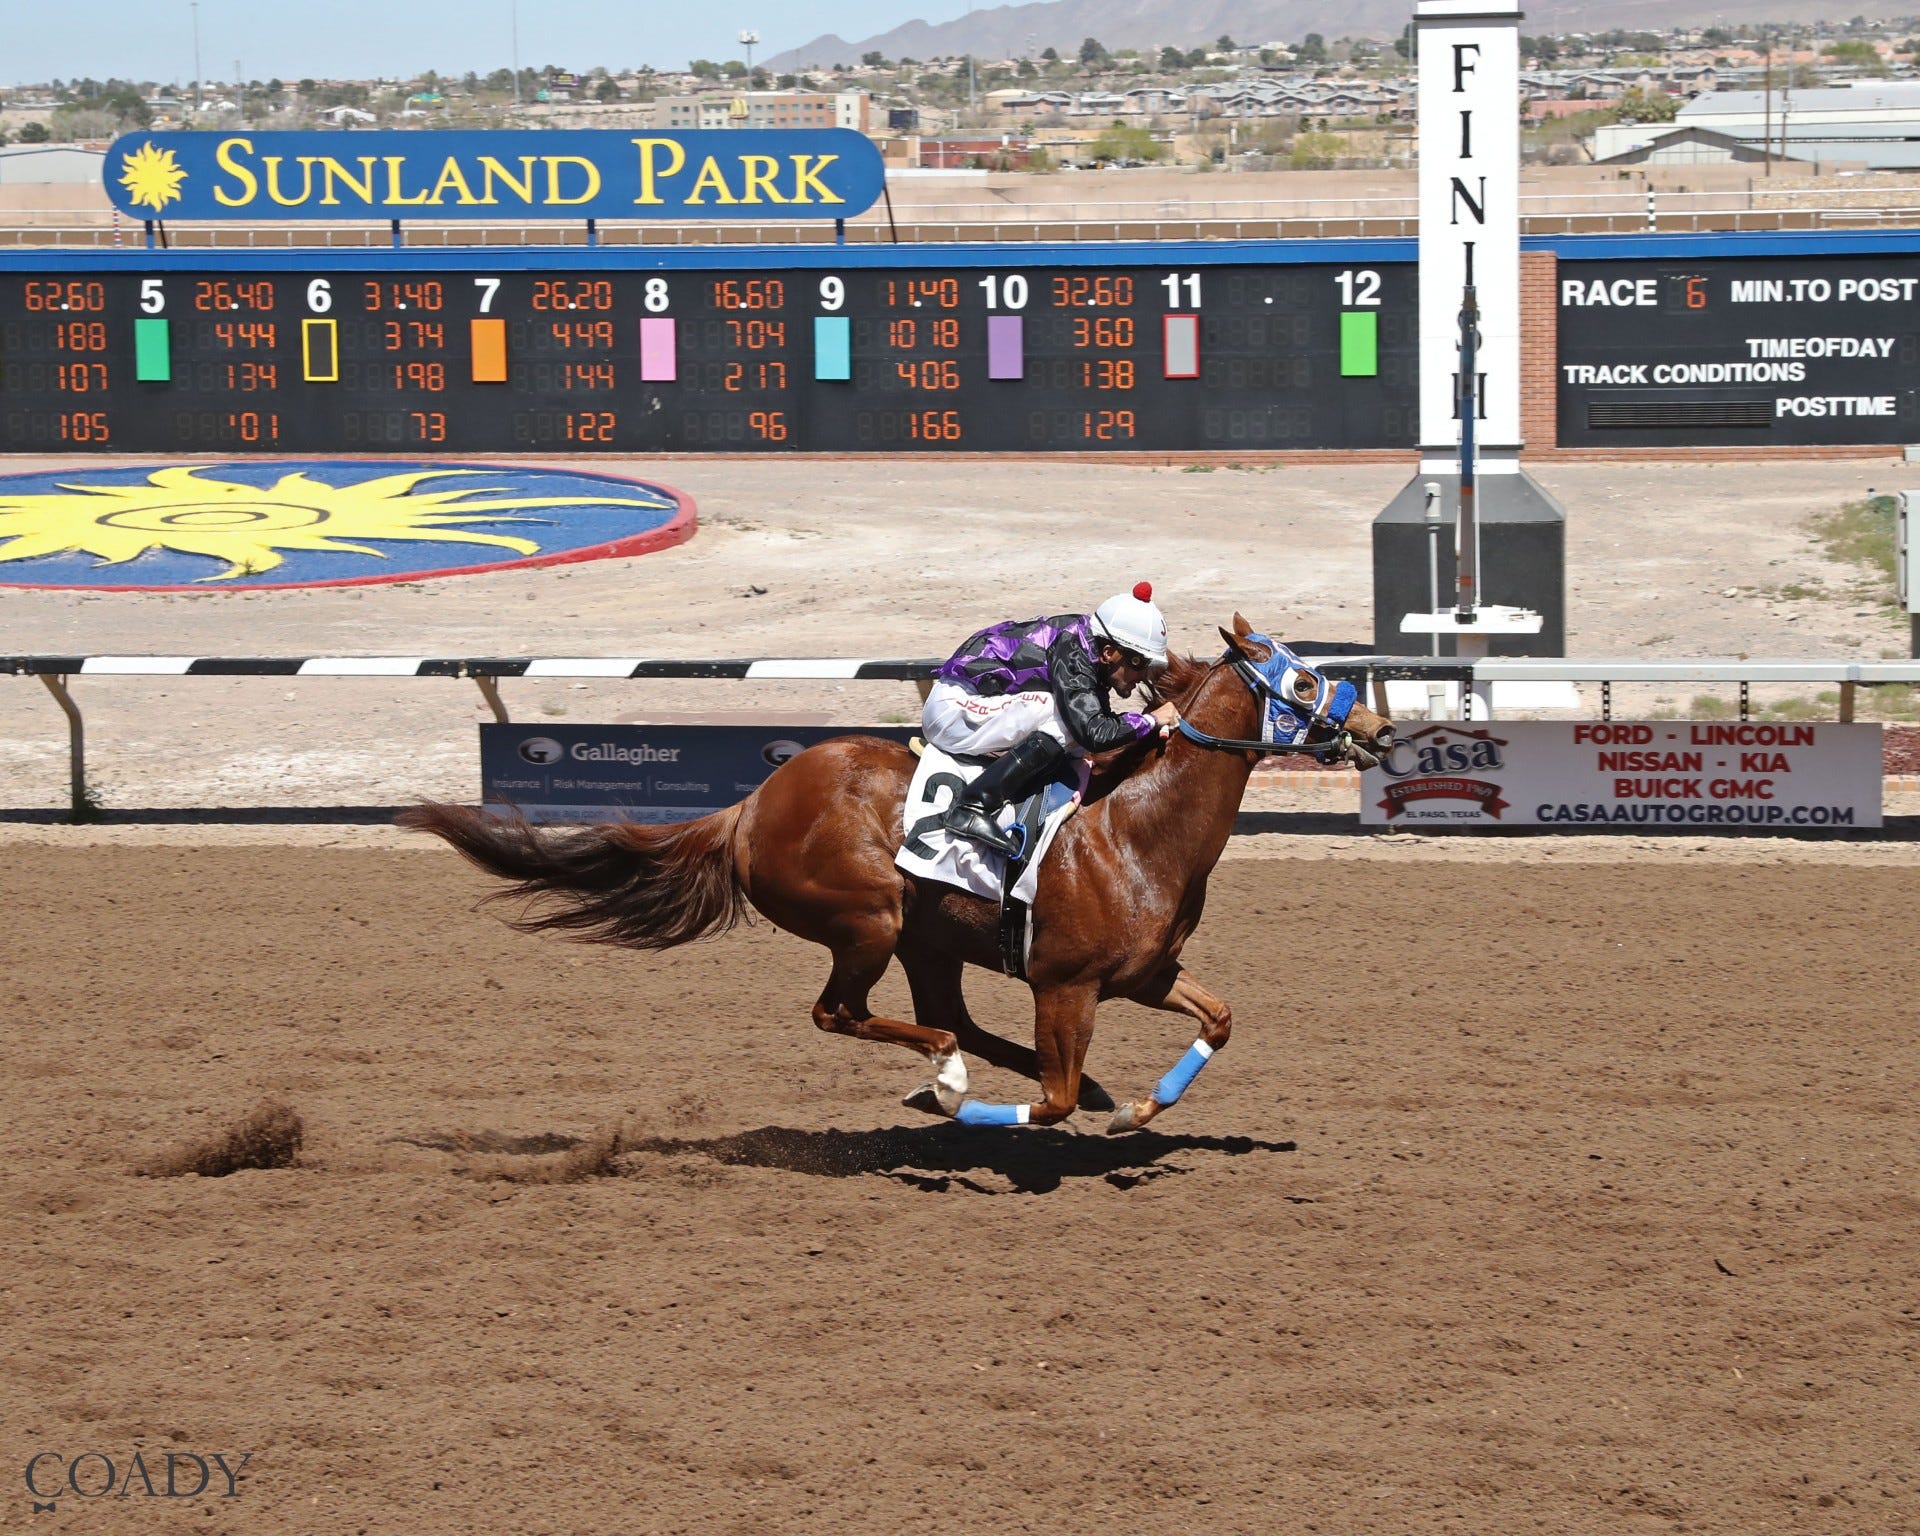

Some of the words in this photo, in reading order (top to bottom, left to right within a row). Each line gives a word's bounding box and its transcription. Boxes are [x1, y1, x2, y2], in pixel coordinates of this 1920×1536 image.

[140, 279, 165, 314] 5
[306, 278, 332, 313] 6
[474, 278, 501, 313] 7
[644, 277, 670, 313] 8
[819, 275, 845, 311] 9
[978, 274, 1029, 310] 10
[1160, 273, 1202, 309] 11
[1334, 270, 1382, 306] 12
[1562, 279, 1658, 307] RACE
[1686, 277, 1707, 309] 6
[1838, 278, 1919, 302] POST
[57, 322, 107, 351] 188
[215, 323, 276, 349] 444
[385, 321, 444, 351] 374
[552, 321, 614, 348] 449
[726, 320, 785, 350] 704
[1074, 317, 1135, 348] 360
[58, 364, 108, 392] 107
[228, 363, 277, 391] 134
[395, 363, 445, 392] 198
[565, 365, 615, 389] 144
[724, 362, 786, 392] 217
[897, 360, 961, 390] 406
[1083, 360, 1135, 390] 138
[1562, 364, 1649, 385] TRACK
[1653, 361, 1806, 384] CONDITIONS
[60, 412, 110, 442] 105
[411, 413, 446, 442] 73
[566, 412, 616, 442] 122
[749, 411, 788, 441] 96
[910, 410, 962, 441] 166
[1084, 410, 1135, 440] 129
[1573, 724, 1654, 745] FORD
[1690, 725, 1815, 746] LINCOLN
[570, 742, 681, 766] Gallagher
[1380, 737, 1504, 779] Casa
[1597, 751, 1703, 772] NISSAN
[1740, 752, 1792, 773] KIA
[493, 778, 541, 790] Insurance
[553, 778, 576, 790] Risk
[577, 779, 643, 792] Management
[655, 780, 710, 793] Consulting
[1390, 781, 1464, 798] ESTABLISHED
[1614, 778, 1703, 799] BUICK
[1708, 778, 1775, 800] GMC
[904, 771, 968, 861] 2
[1405, 811, 1416, 819] EL
[1452, 811, 1482, 819] TEXAS
[1536, 803, 1855, 826] CASAAUTOGROUP.COM
